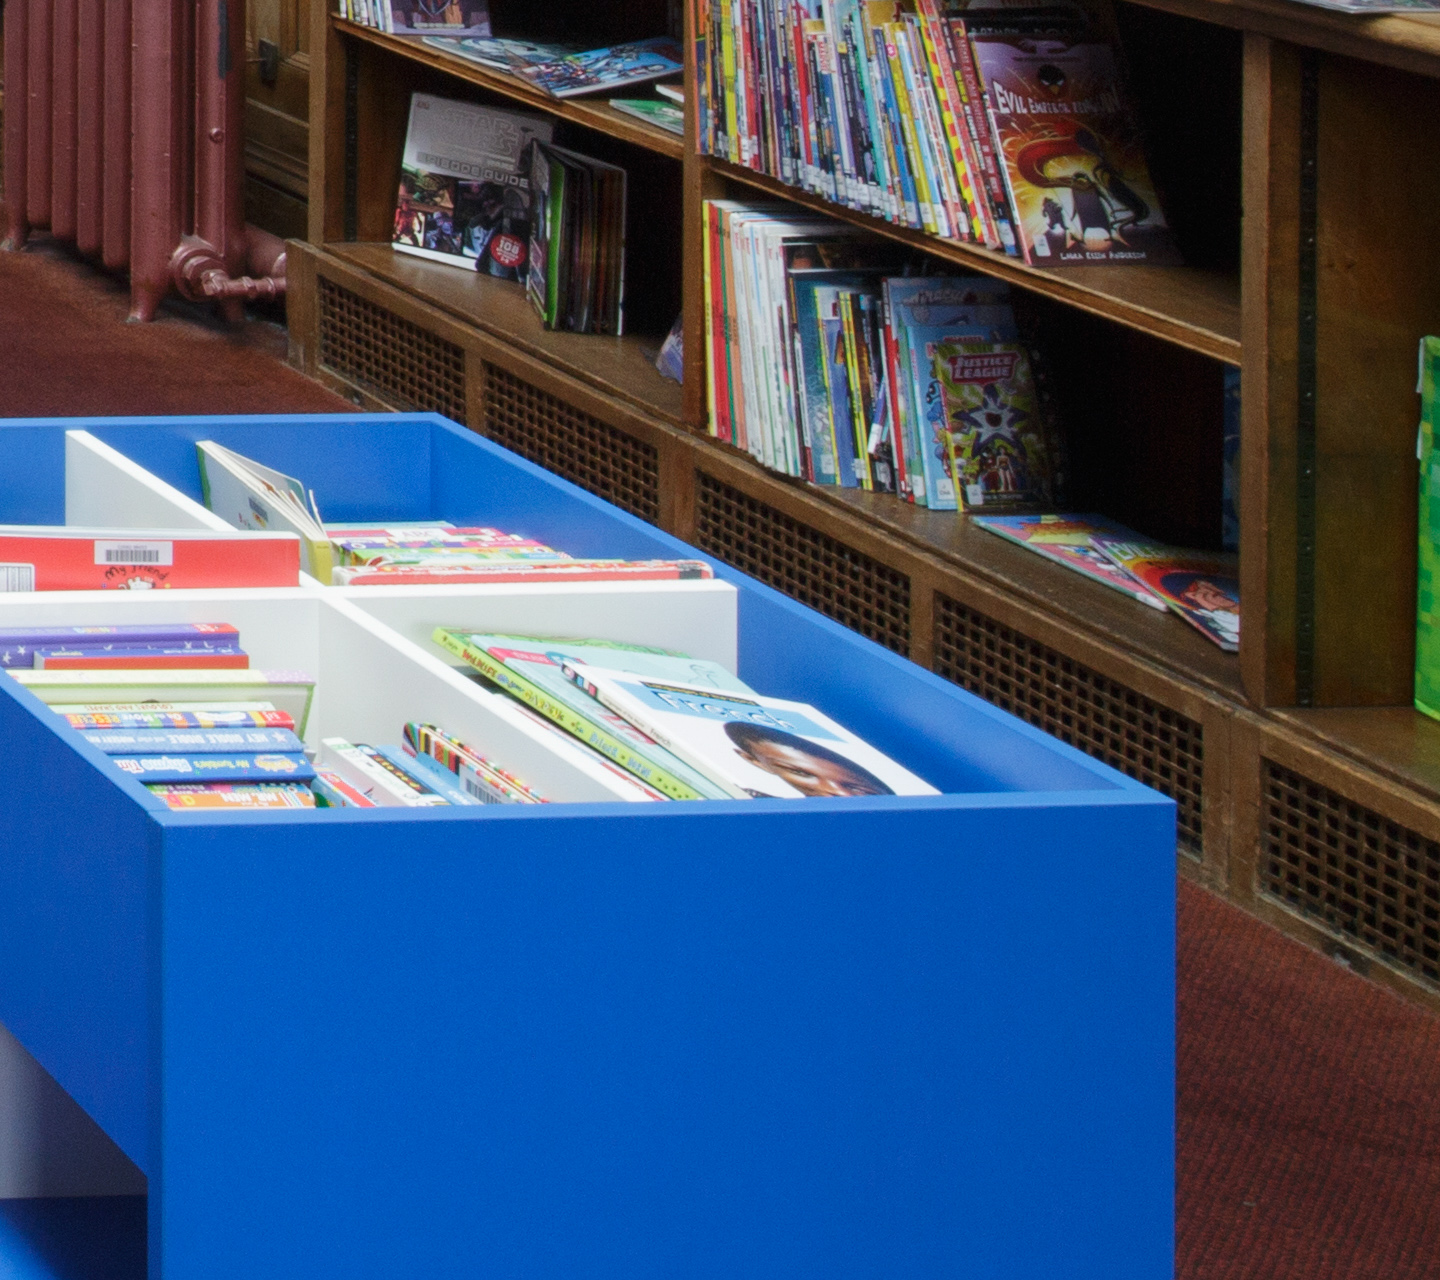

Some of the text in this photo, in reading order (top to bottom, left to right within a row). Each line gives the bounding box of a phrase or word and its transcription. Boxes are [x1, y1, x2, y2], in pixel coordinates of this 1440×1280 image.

[416, 152, 478, 178] EPISODE
[483, 170, 529, 189] GUIDE
[499, 242, 520, 255] 108
[954, 356, 1013, 367] JUSTICE
[954, 366, 1011, 379] LEAGUE
[104, 564, 170, 583] My friend
[652, 691, 798, 729] French
[650, 728, 672, 747] French
